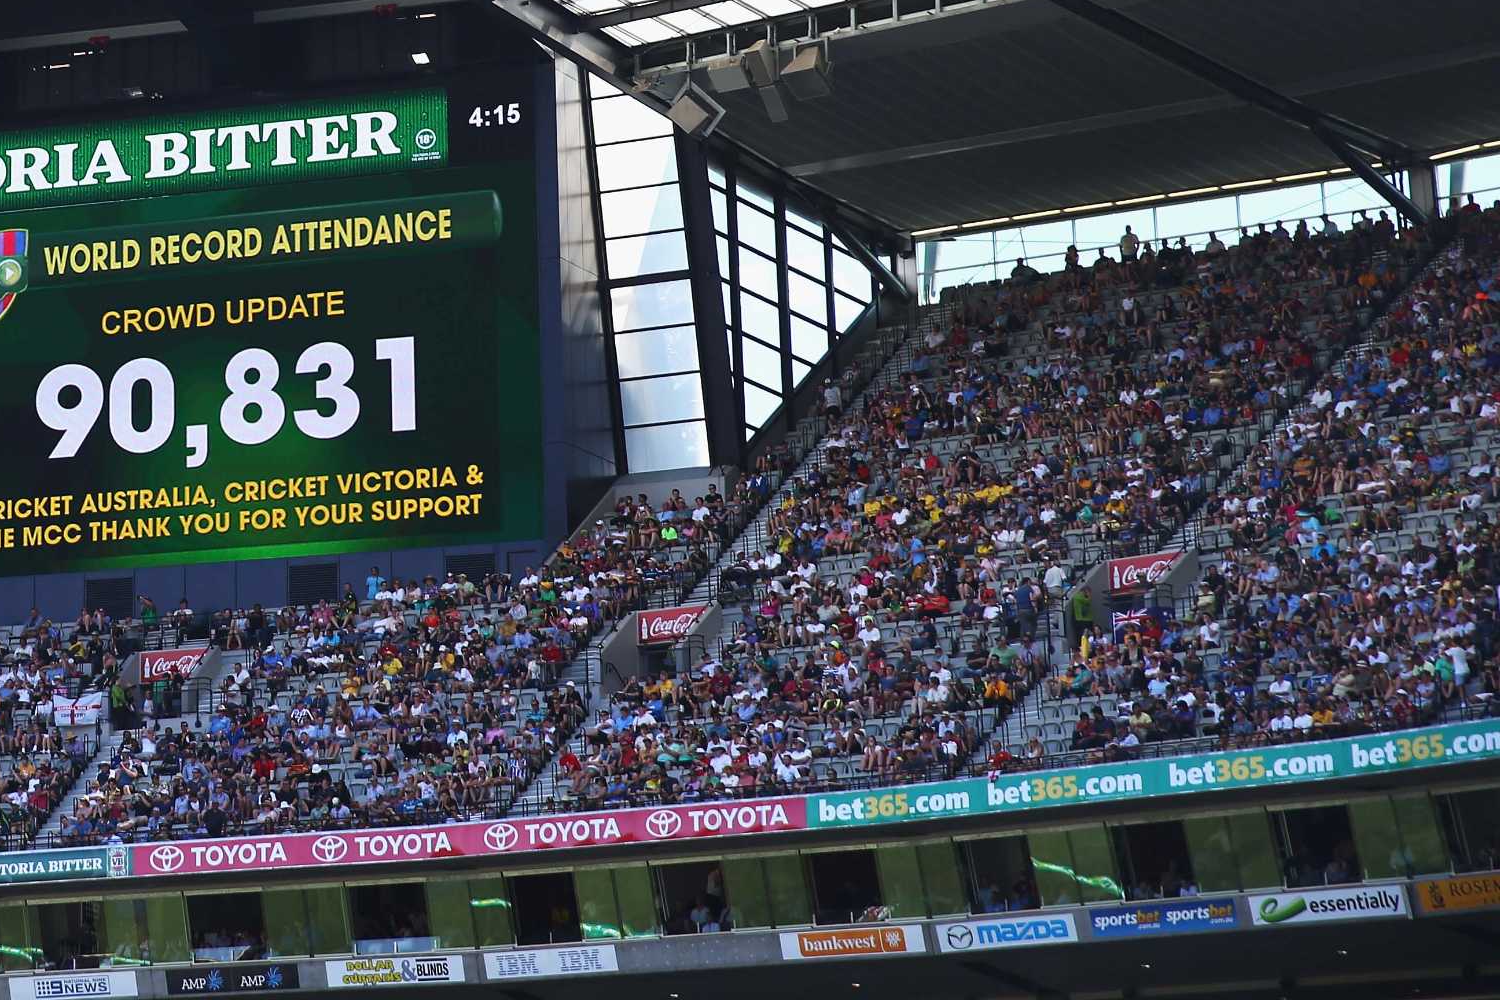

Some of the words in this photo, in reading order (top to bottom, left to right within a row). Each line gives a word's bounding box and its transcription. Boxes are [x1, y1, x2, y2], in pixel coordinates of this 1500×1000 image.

[469, 103, 520, 127] 4:15
[145, 111, 402, 178] BITTER
[43, 239, 140, 275] WORLD
[150, 227, 262, 266] RECORD
[271, 209, 452, 255] ATTENDANCE
[101, 303, 215, 335] CROWD
[226, 291, 345, 323] UPDATE
[35, 336, 417, 468] 90,831
[81, 485, 216, 514] AUSTRALIA,
[224, 475, 329, 504] CRICKET
[337, 466, 457, 495] VICTORIA
[465, 464, 484, 485] &
[22, 523, 81, 547] MCC
[88, 517, 170, 542] THANK
[180, 512, 230, 537] YOU
[239, 509, 286, 533] FOR
[294, 504, 362, 528] YOUR
[371, 494, 483, 521] SUPPORT
[1169, 749, 1335, 787] bet365.com
[987, 770, 1143, 806] bet365.com
[819, 788, 970, 822] bet365.com
[688, 804, 789, 832] TOYOTA
[525, 817, 621, 845] TOYOTA
[191, 842, 287, 867] TOYOTA
[355, 832, 452, 858] TOYOTA
[49, 857, 102, 873] BITTER
[1166, 904, 1232, 925] sportsbet
[1309, 891, 1399, 913] essentially
[976, 919, 1068, 944] mazda
[1094, 910, 1159, 931] sportsbet
[803, 933, 876, 952] bankwest
[346, 959, 395, 972] DOLLAR
[401, 959, 417, 982] &
[416, 962, 449, 977] BLINDS
[496, 953, 539, 976] IBM
[558, 949, 602, 971] IBM
[64, 981, 107, 994] NEWS
[181, 977, 206, 990] AMP
[240, 975, 266, 987] AMP
